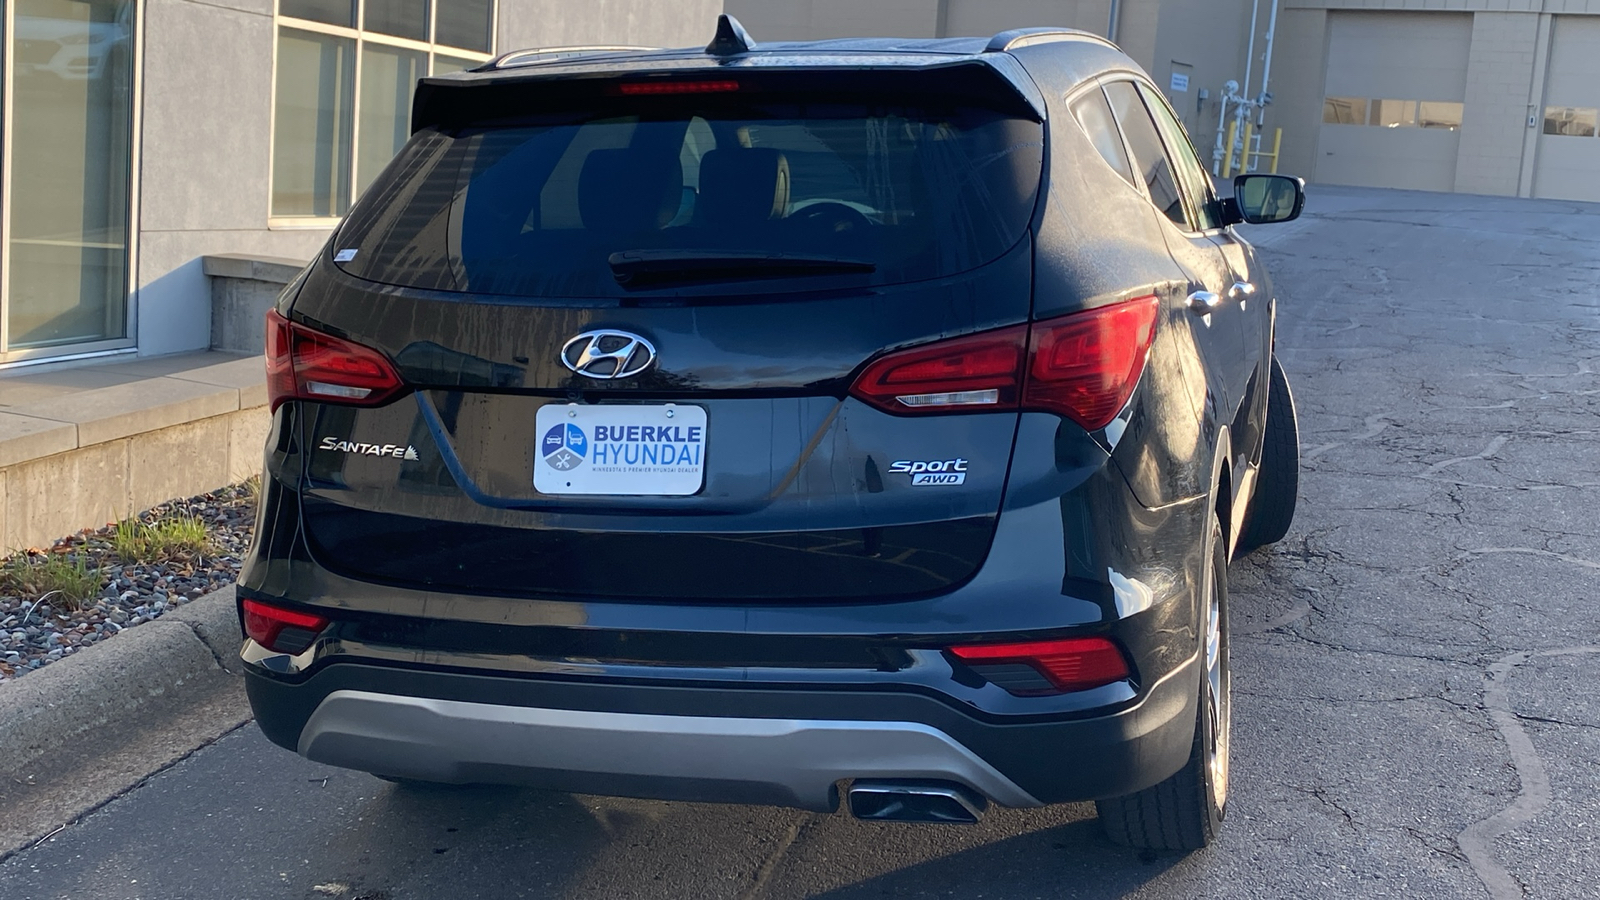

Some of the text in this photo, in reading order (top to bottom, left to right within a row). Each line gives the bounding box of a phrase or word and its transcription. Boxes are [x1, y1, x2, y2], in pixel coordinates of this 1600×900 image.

[594, 425, 701, 442] BUERKLE
[592, 443, 700, 465] HYUNDAI
[888, 458, 968, 475] Sport
[917, 475, 959, 484] AWD
